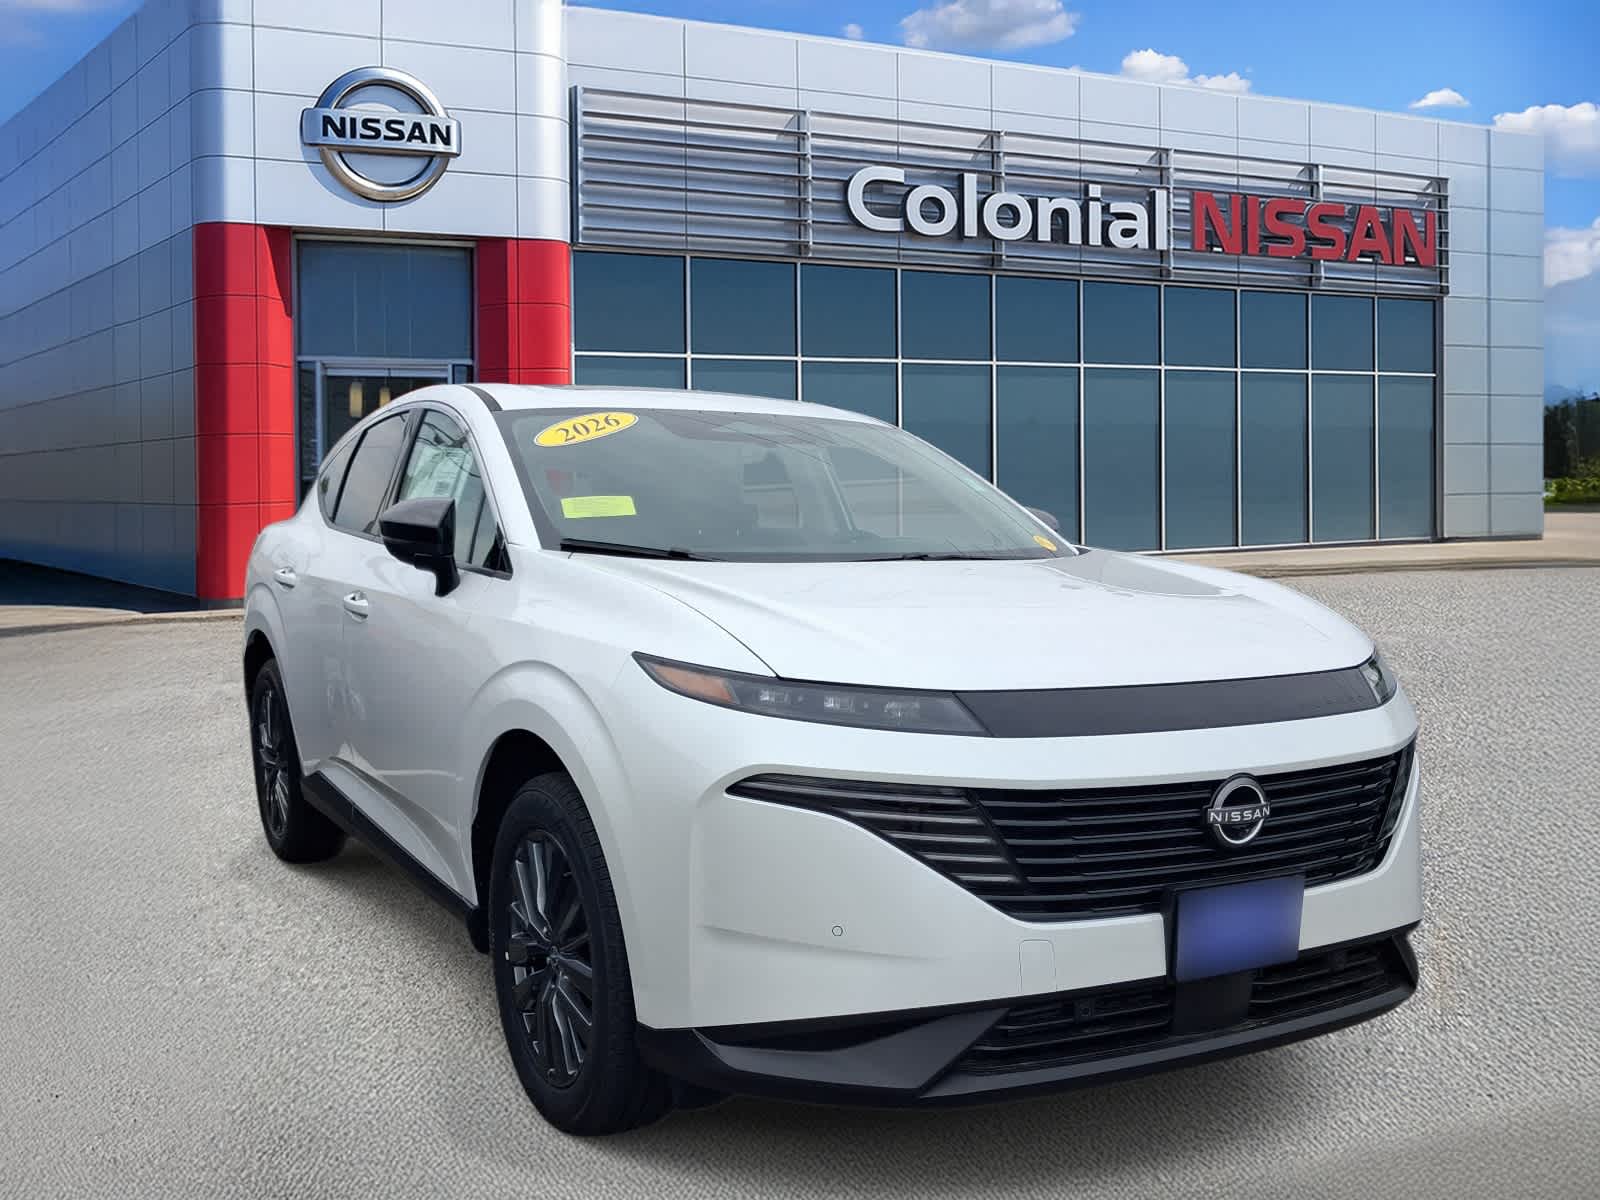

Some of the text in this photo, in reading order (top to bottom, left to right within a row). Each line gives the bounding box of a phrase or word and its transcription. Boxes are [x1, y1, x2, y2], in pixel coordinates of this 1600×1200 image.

[322, 115, 451, 145] NISSAN
[847, 166, 1436, 267] Colonial NISSAN
[557, 415, 620, 442] 2026
[1210, 806, 1270, 822] NISSAN
